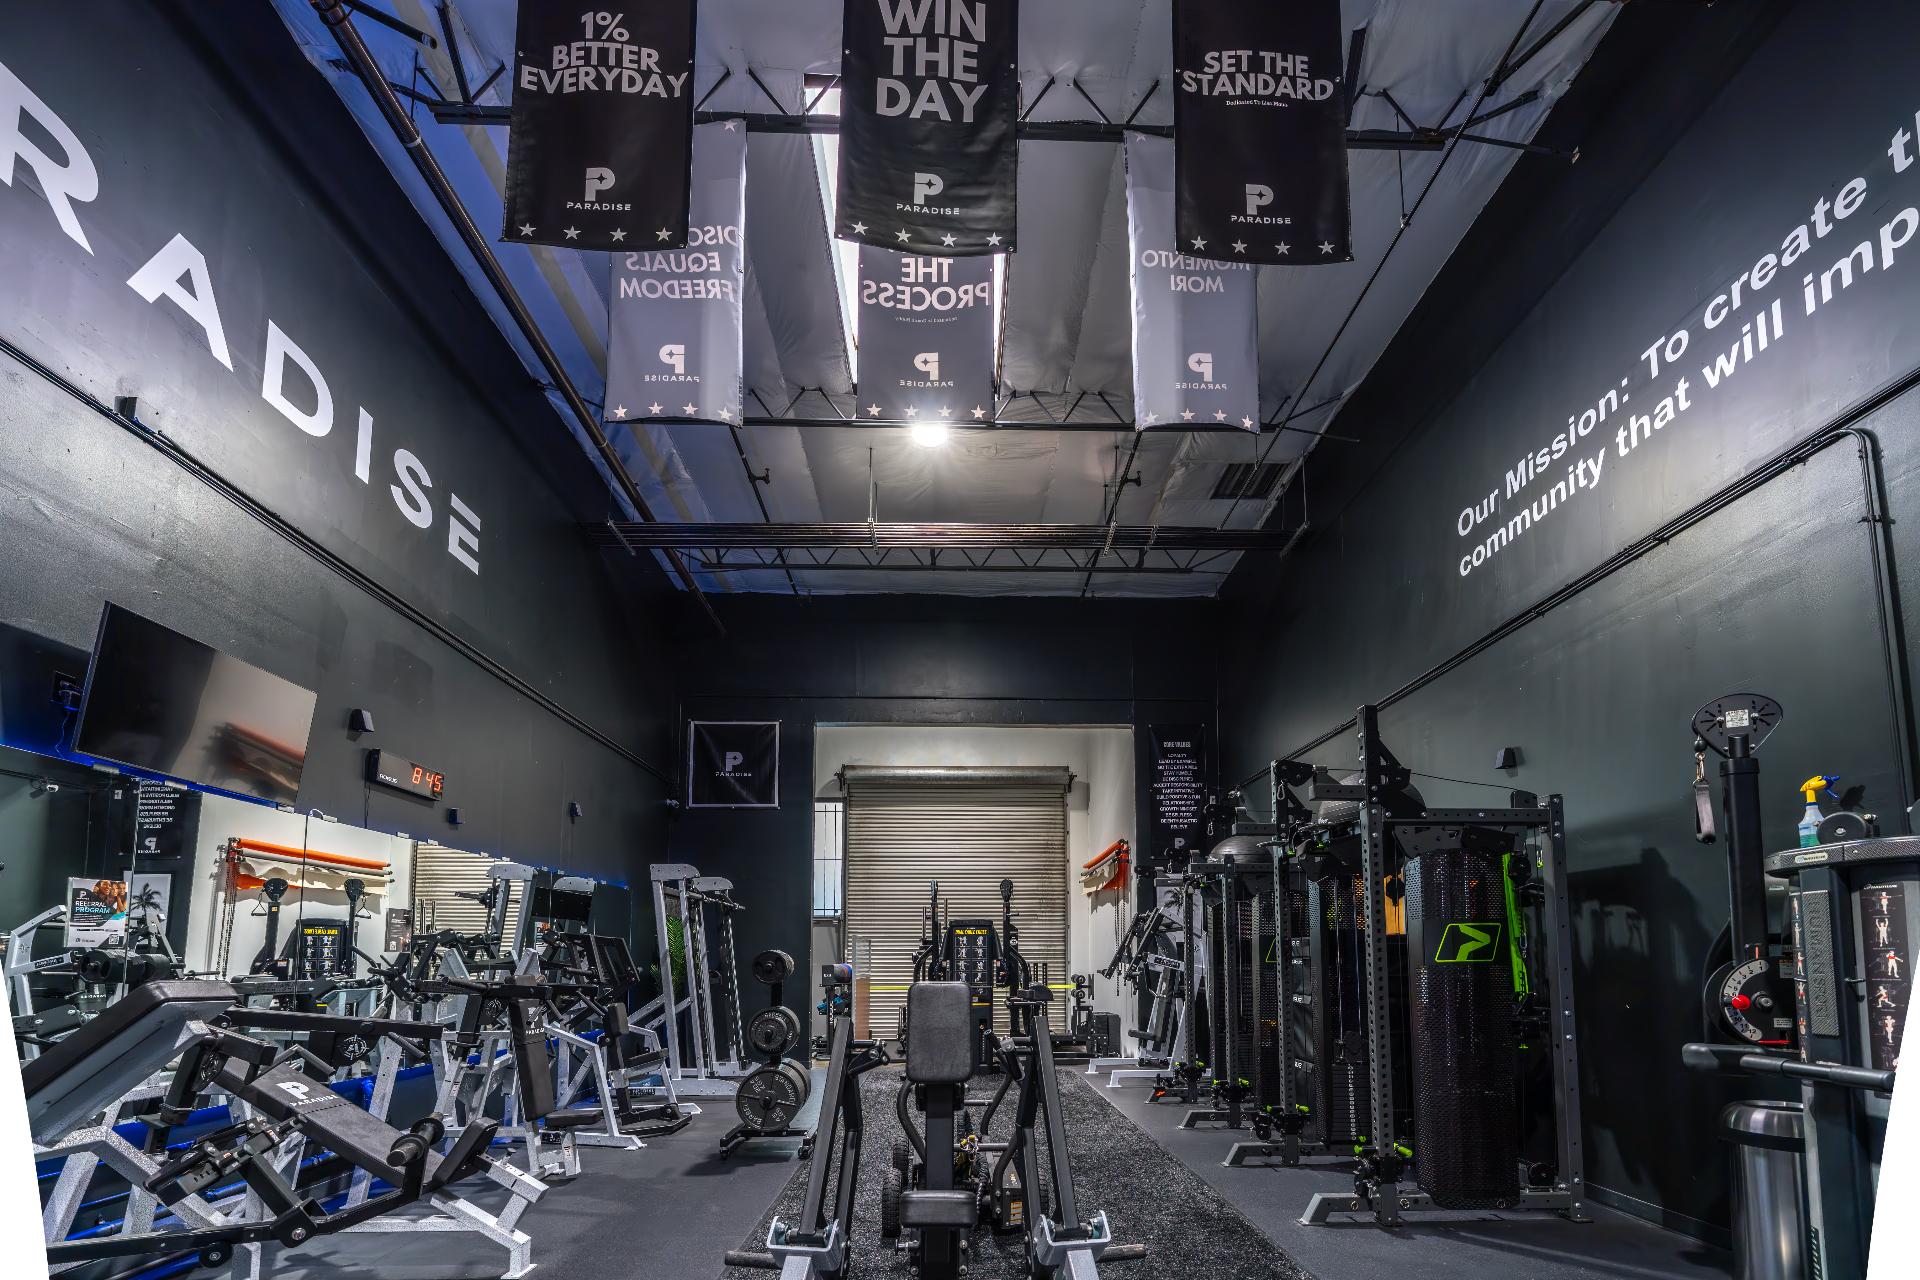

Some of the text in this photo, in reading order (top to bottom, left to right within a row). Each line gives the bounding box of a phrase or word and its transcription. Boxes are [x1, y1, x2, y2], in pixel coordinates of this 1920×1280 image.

[581, 11, 630, 42] 1%
[878, 0, 986, 42] WIN
[552, 41, 662, 74] BETTER
[883, 36, 978, 83] THE
[1203, 50, 1309, 78] SET THE
[520, 64, 689, 98] EVERYDAY
[1181, 70, 1334, 101] STANDARD
[876, 77, 989, 123] DAY
[566, 201, 632, 211] PARADISE
[896, 203, 960, 215] PARADISE
[1230, 215, 1292, 225] PARADISE
[1457, 109, 1920, 537] Our Mission: To create t
[1459, 447, 1606, 577] community
[1615, 376, 1692, 458] that
[1702, 298, 1784, 388] will
[75, 906, 110, 914] PROGRAM
[289, 1094, 340, 1107] PARADISE
